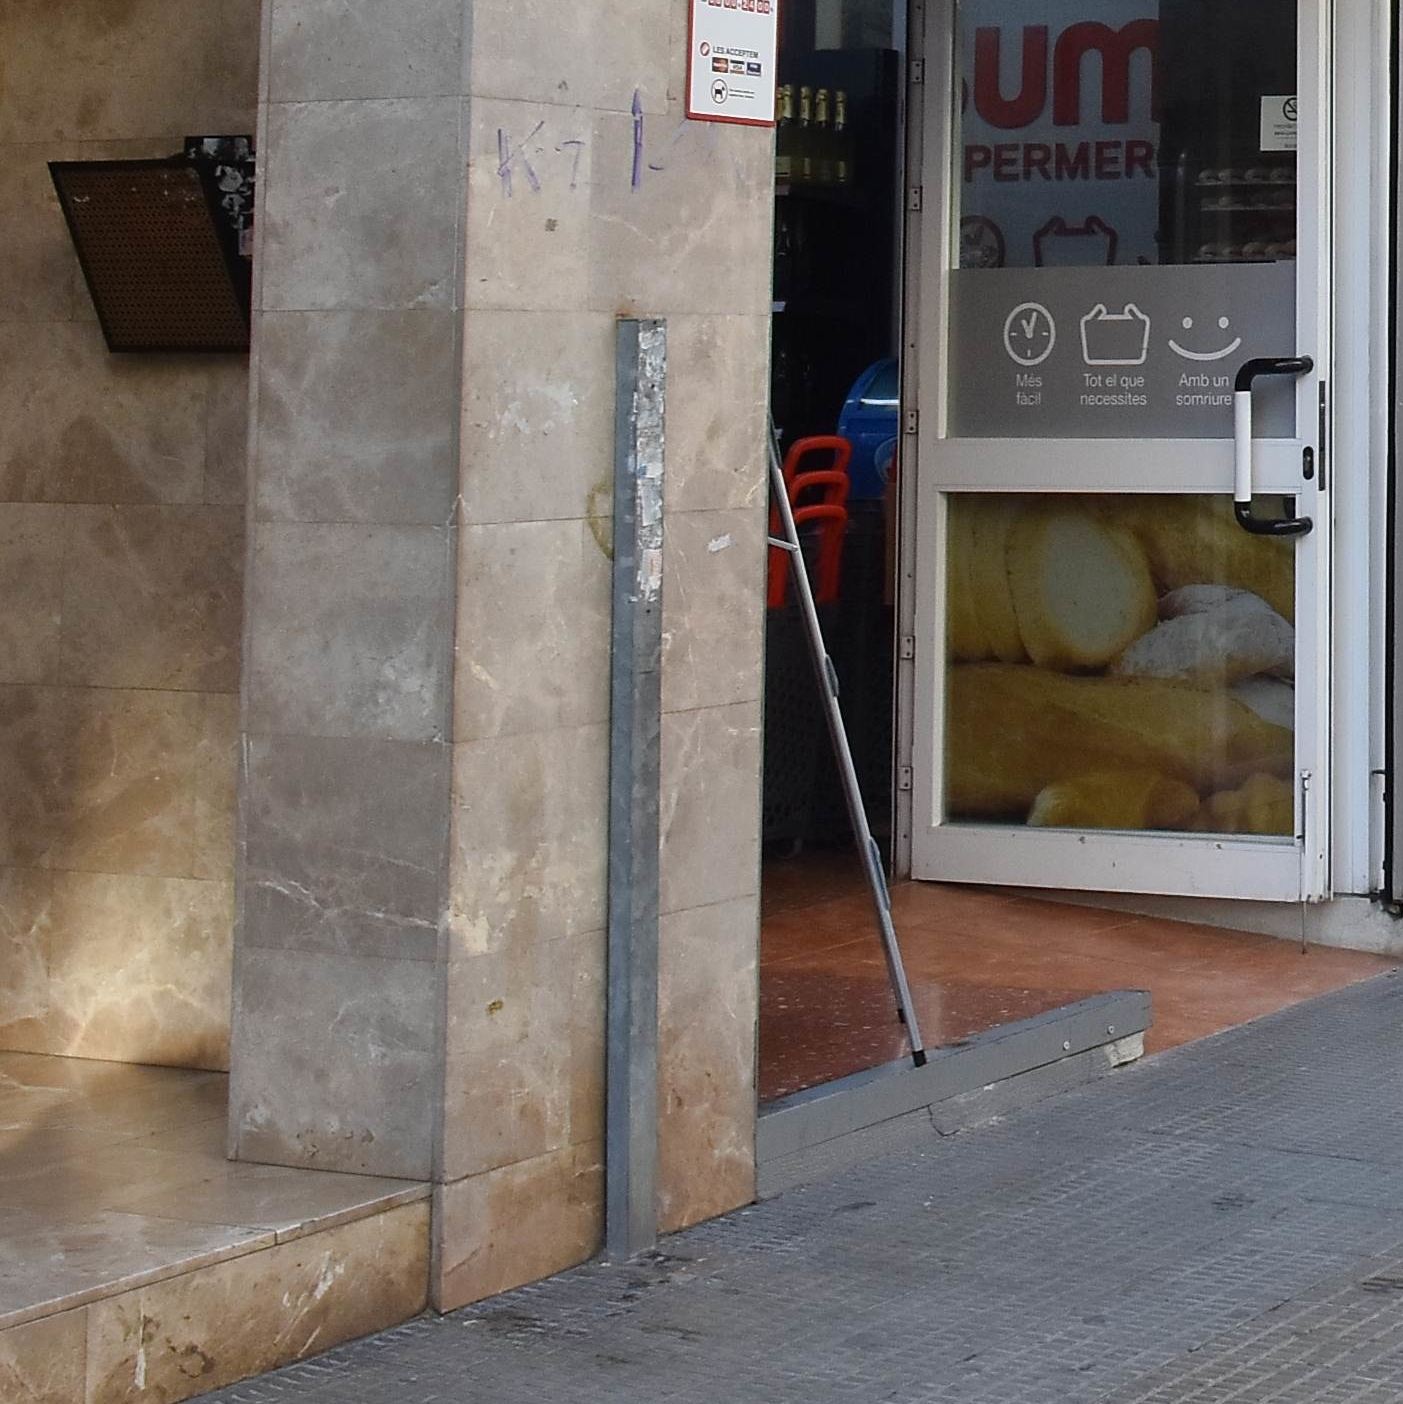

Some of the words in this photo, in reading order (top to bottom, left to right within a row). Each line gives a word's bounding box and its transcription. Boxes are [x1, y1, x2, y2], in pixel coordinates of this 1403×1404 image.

[962, 18, 1160, 129] um
[1016, 374, 1042, 388] Més
[1083, 374, 1102, 387] Tot
[1106, 374, 1117, 387] el
[1120, 376, 1144, 390] que
[1179, 373, 1209, 387] Amb
[1213, 376, 1229, 387] un
[1080, 393, 1147, 406] necessites
[1176, 393, 1232, 406] somriure
